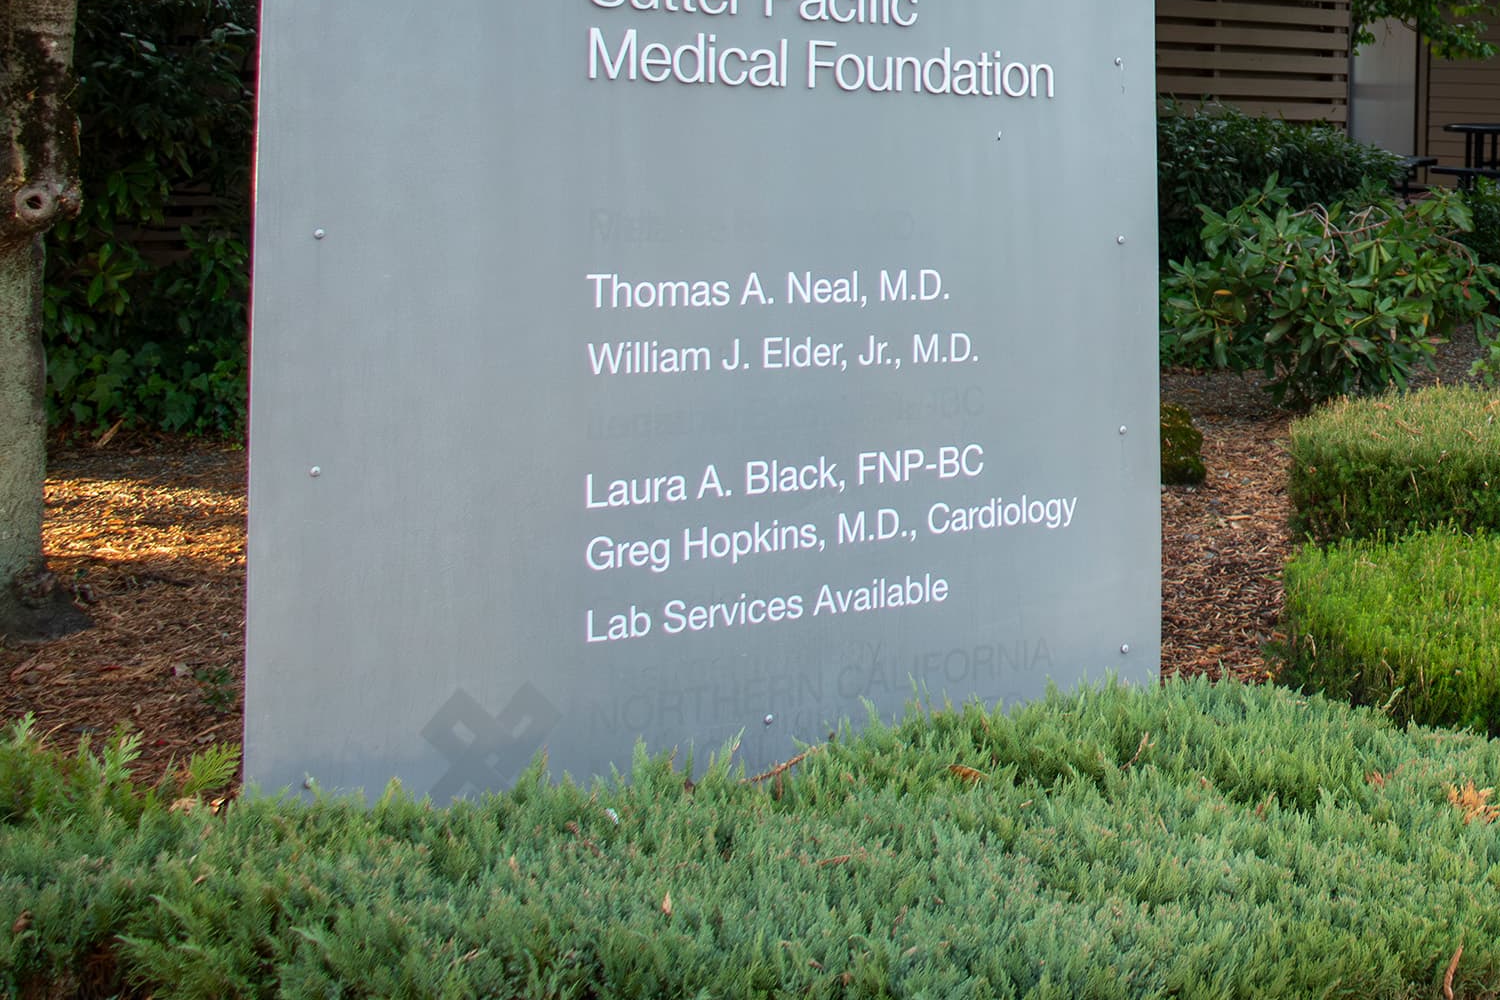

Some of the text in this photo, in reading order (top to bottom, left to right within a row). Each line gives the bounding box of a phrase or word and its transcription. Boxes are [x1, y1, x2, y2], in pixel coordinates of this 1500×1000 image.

[589, 26, 1054, 98] Medical Foundation
[585, 269, 950, 309] Thomas A. Neal, M.D.
[587, 332, 979, 375] William J. Elder, Jr., M.D.
[585, 443, 984, 509] Laura A. Black, FNP-BC
[585, 494, 1078, 573] Greg Hopkins, M.D., Cardiology
[586, 572, 949, 643] Lab Services Available
[590, 673, 823, 735] NORTHERN
[837, 638, 1053, 697] CALIFORNIA
